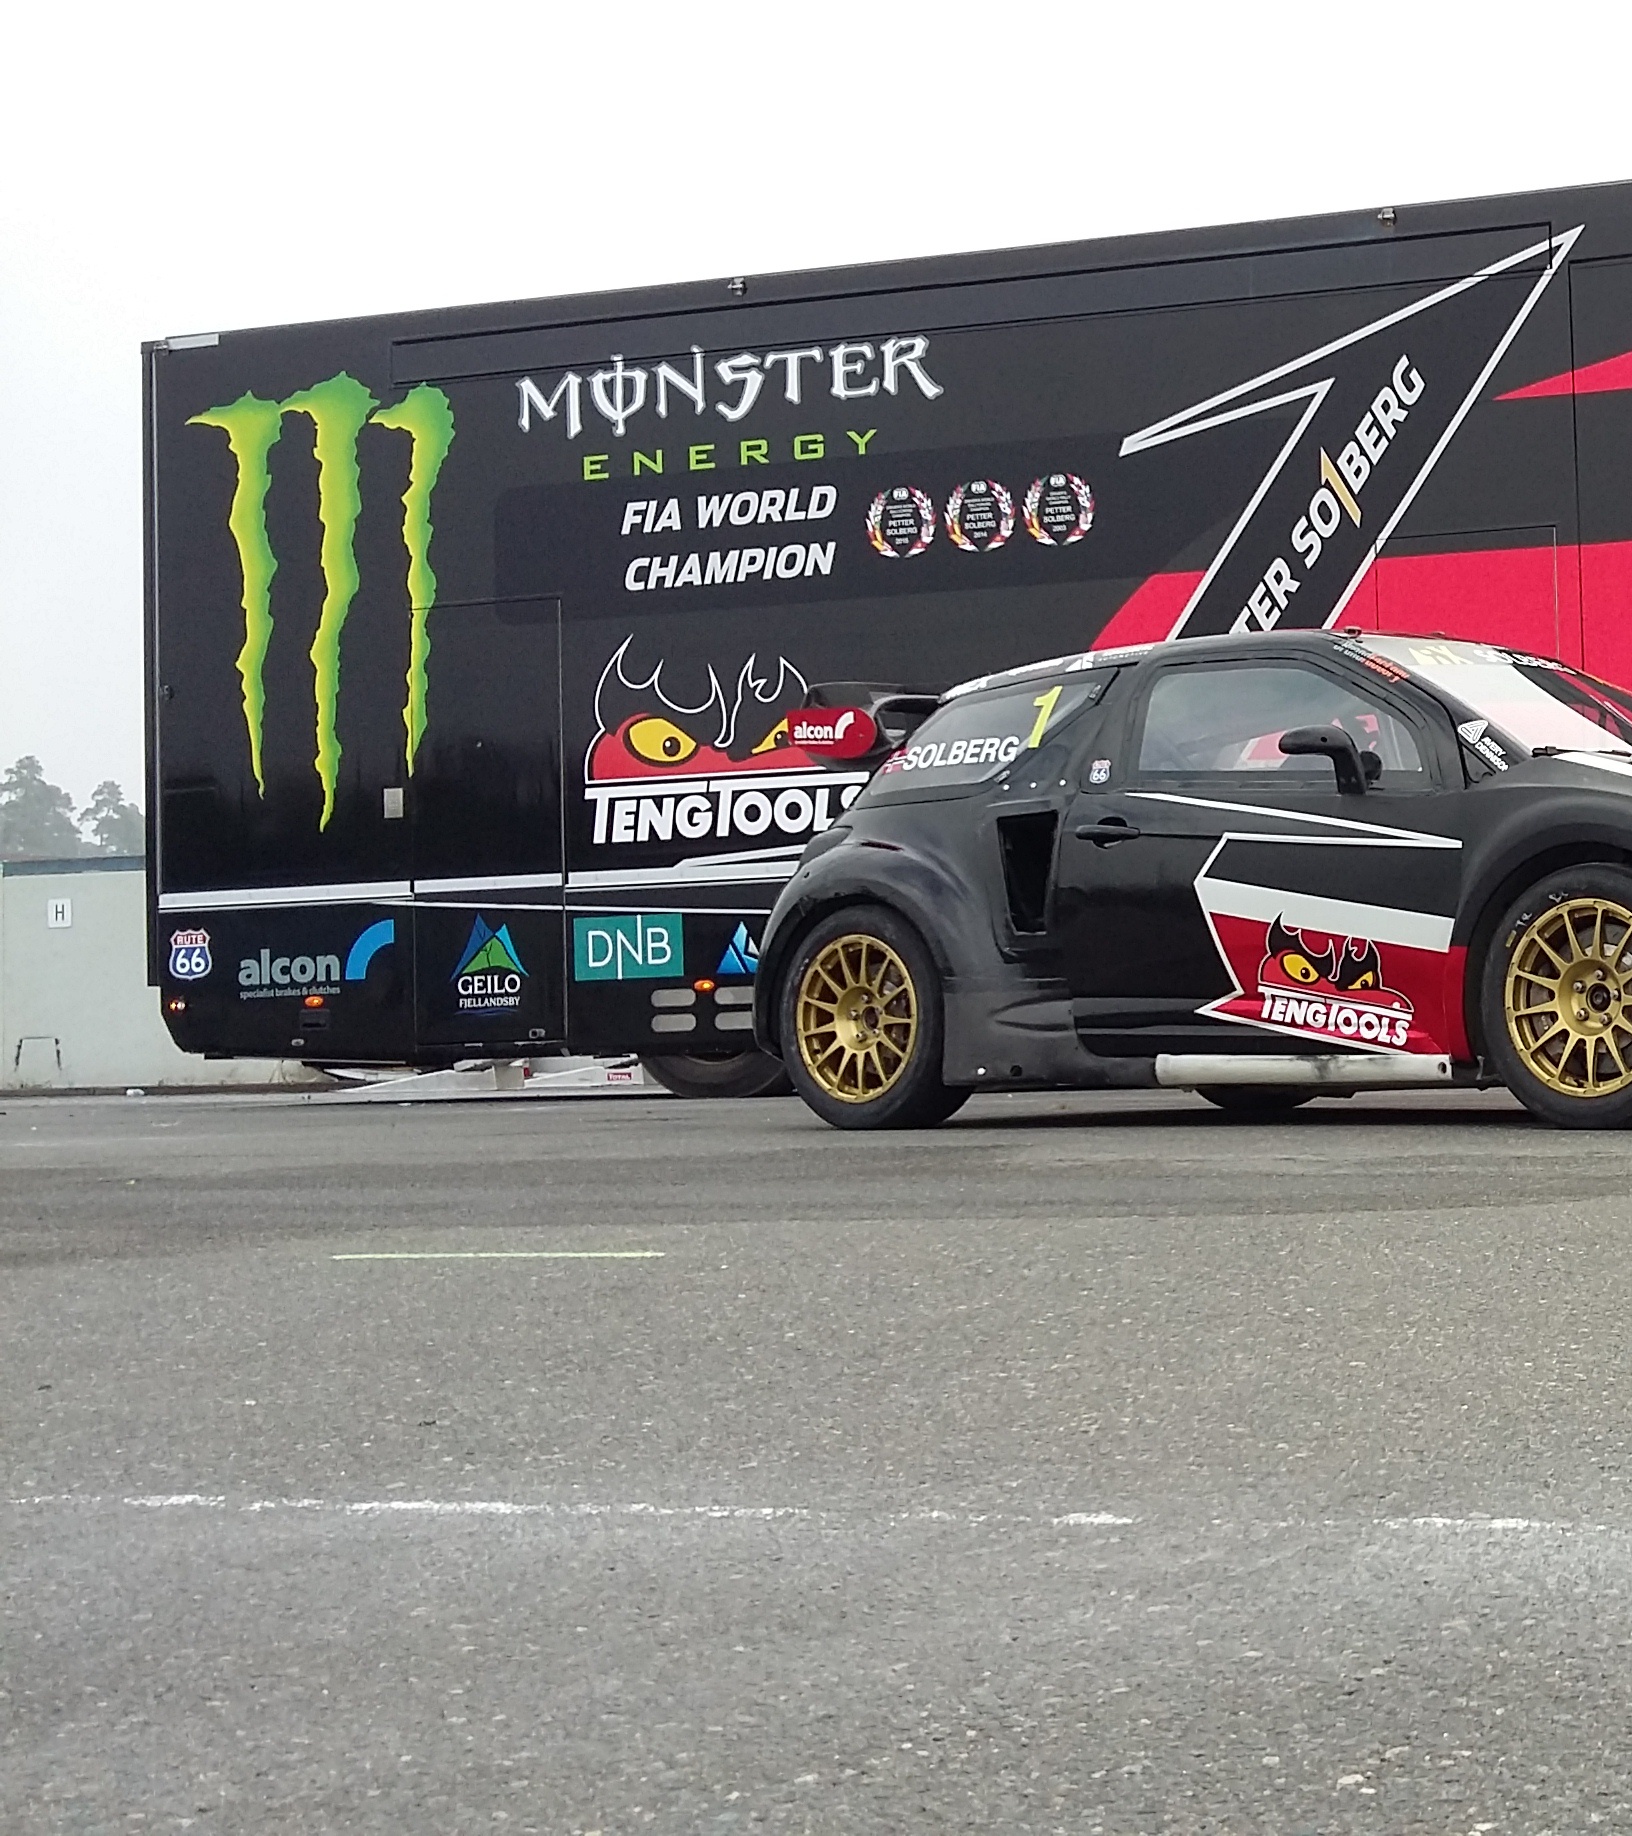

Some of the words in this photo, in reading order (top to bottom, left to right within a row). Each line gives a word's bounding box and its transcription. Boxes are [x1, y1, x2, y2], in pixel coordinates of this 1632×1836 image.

[517, 334, 944, 439] MONSTER
[582, 428, 878, 482] ENERGY
[620, 497, 682, 536] FIA
[696, 484, 838, 529] WORLD
[623, 541, 836, 592] CHAMPION
[793, 720, 834, 740] alcon
[1027, 685, 1063, 749] 1
[901, 735, 1020, 771] SOLBERG
[1480, 736, 1507, 757] AVERY
[1092, 768, 1107, 781] 66
[55, 903, 65, 922] H
[176, 934, 204, 945] RUTE
[587, 914, 672, 980] DNB
[175, 948, 206, 974] 66
[237, 948, 341, 986] alcon
[275, 986, 301, 997] brakes
[457, 973, 521, 996] GEILO
[459, 996, 521, 1009] FJELLANDSBY
[1257, 984, 1413, 1047] TENGTOOLS
